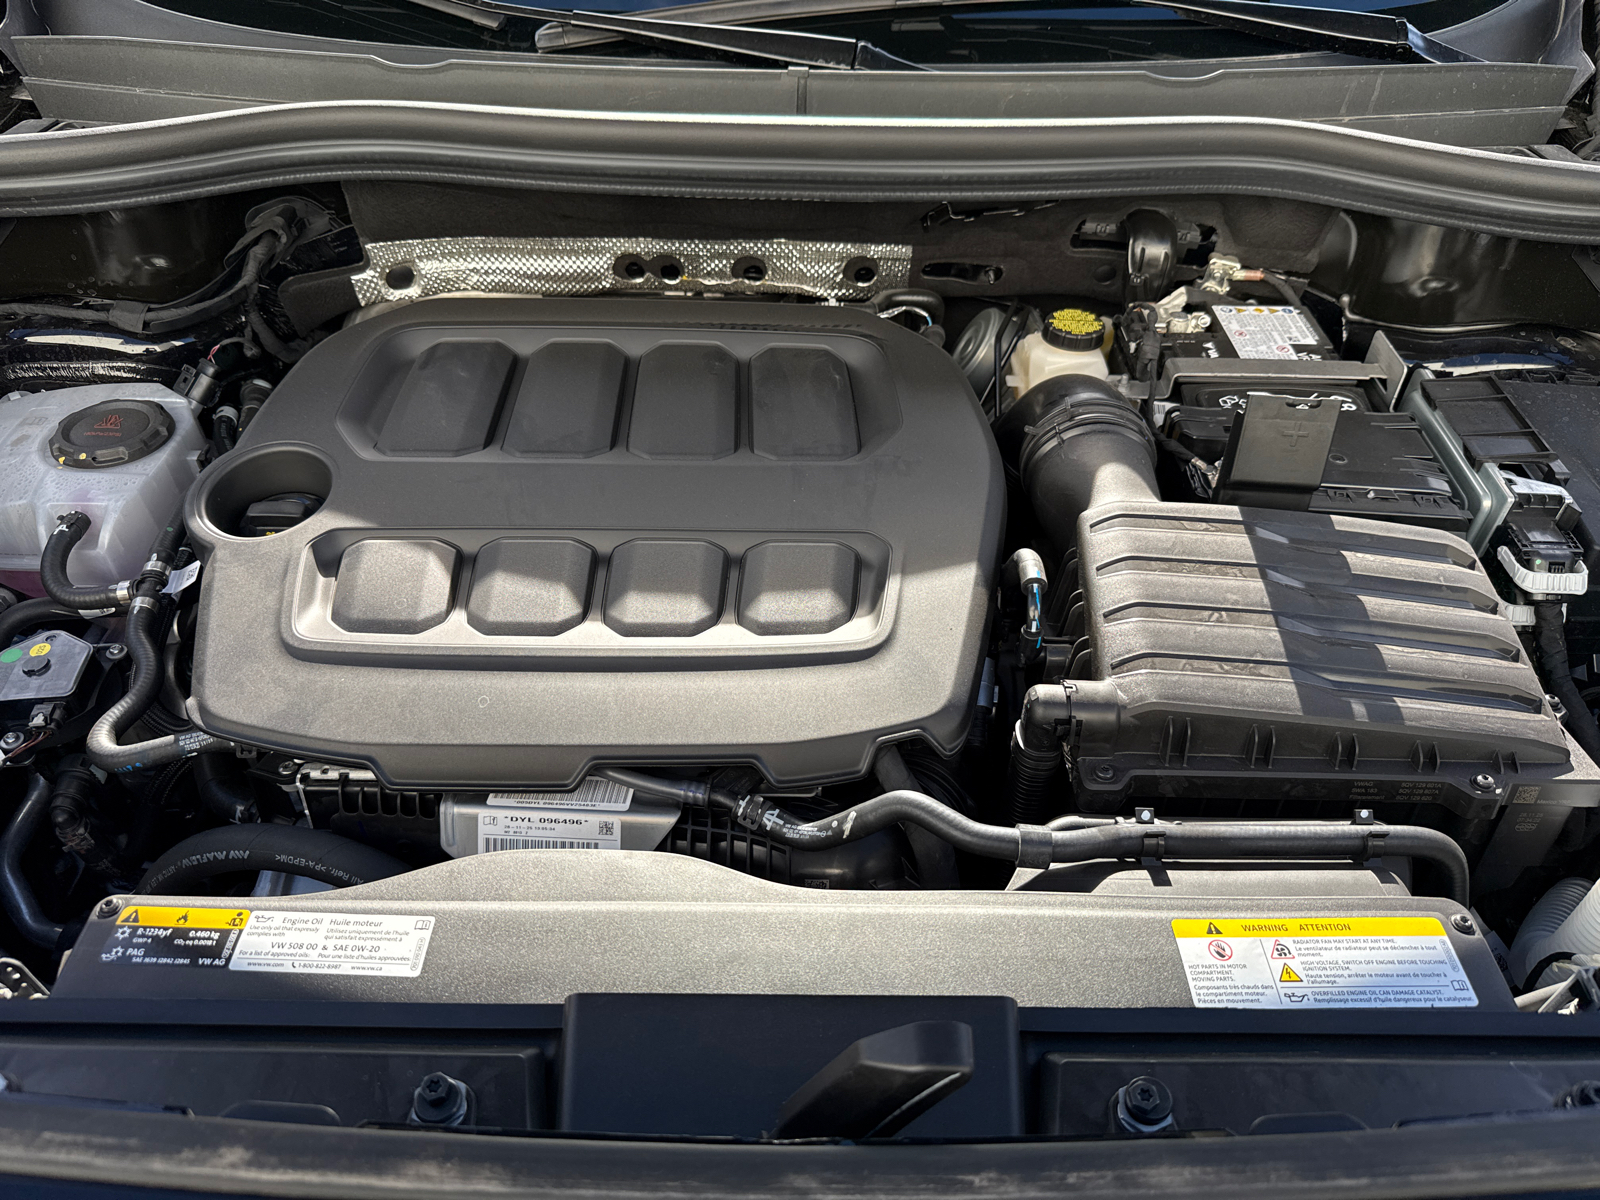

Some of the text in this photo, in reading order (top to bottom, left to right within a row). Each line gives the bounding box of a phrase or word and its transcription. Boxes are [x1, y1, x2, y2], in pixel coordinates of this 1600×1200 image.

[282, 917, 310, 925] Engine
[1241, 924, 1288, 932] WARNING
[137, 928, 173, 938] R-1234yf
[189, 930, 210, 938] 0.460
[298, 962, 342, 970] 1-800-822-8987
